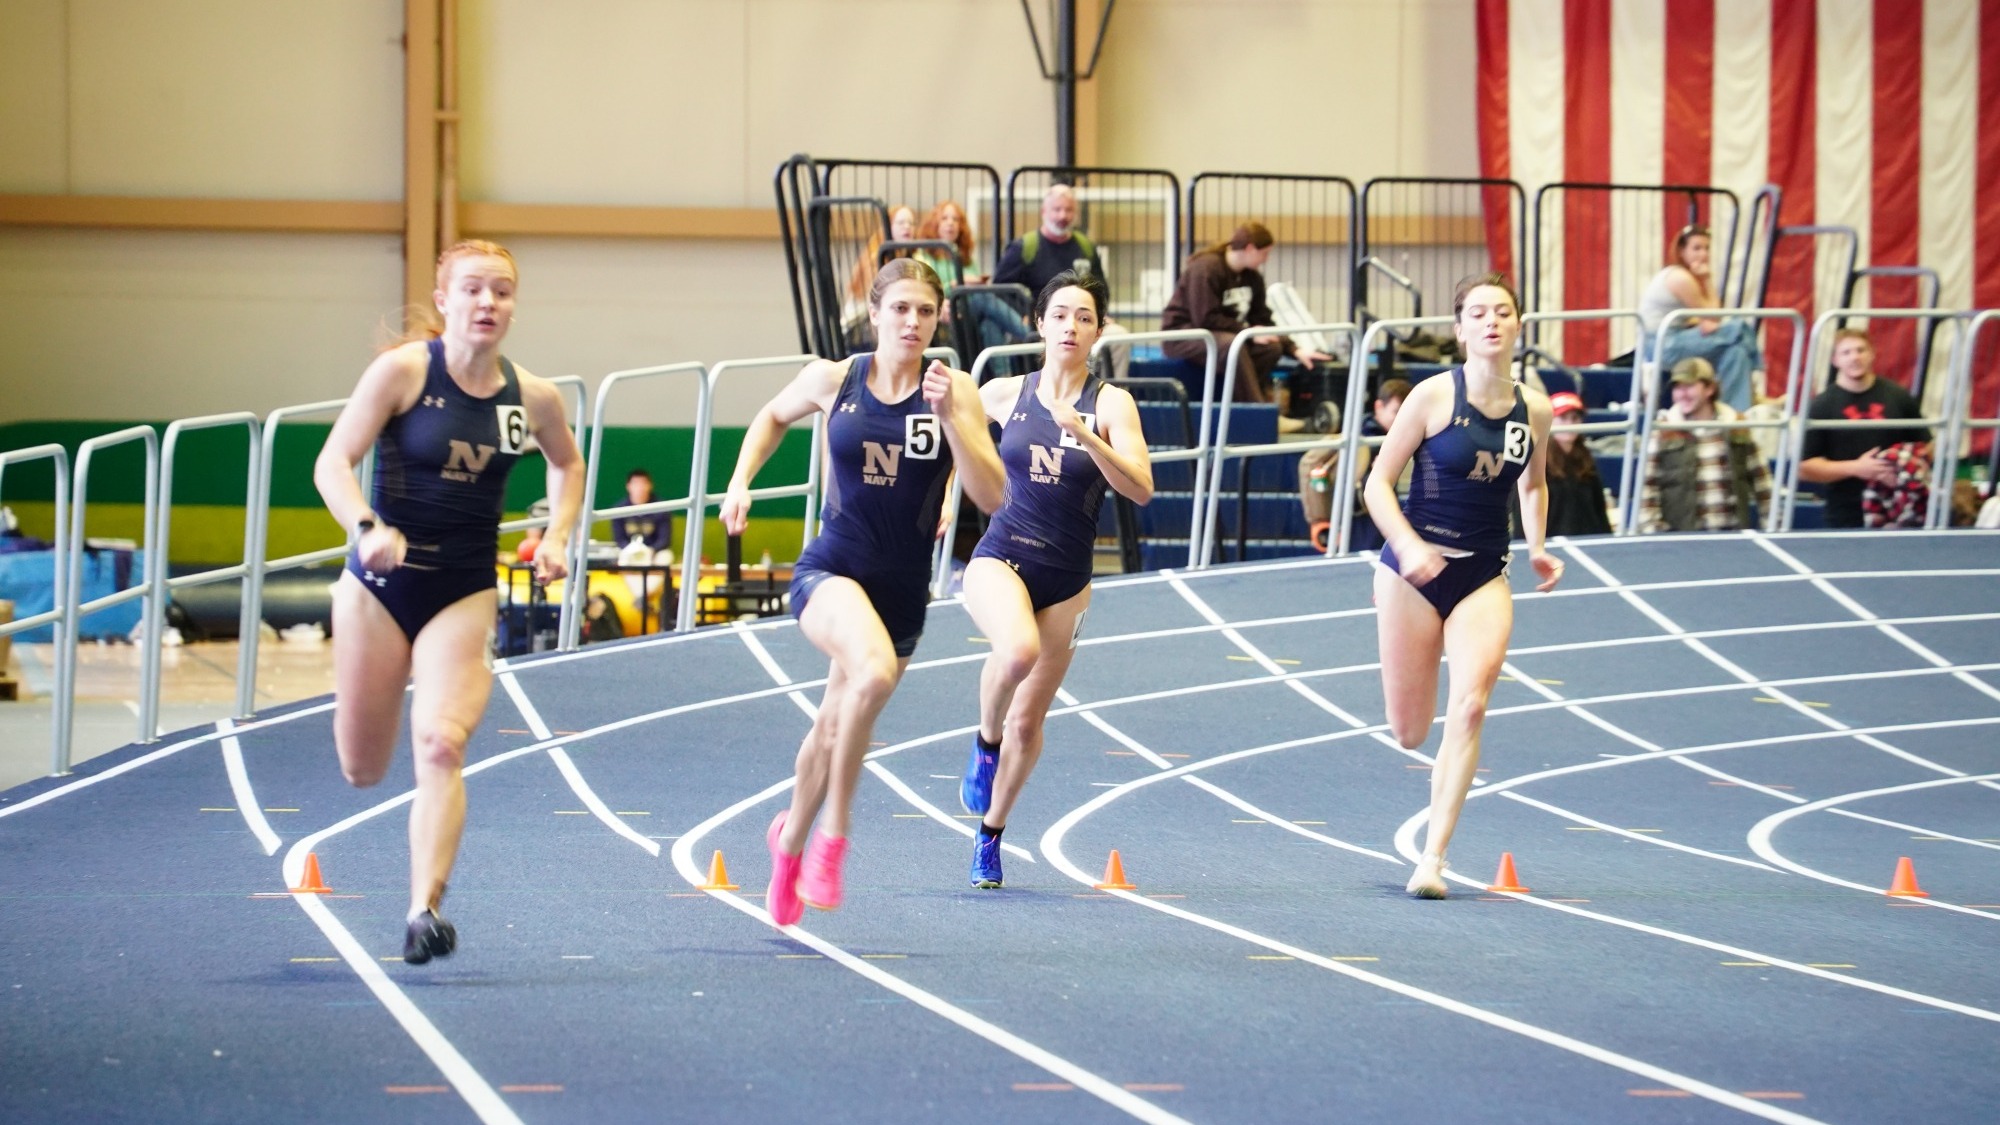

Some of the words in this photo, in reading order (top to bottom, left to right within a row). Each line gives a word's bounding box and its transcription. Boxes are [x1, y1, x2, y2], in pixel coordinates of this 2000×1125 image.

[507, 410, 523, 450] 6
[910, 418, 934, 455] 5
[1509, 427, 1526, 459] 3
[444, 440, 497, 473] N
[862, 441, 903, 476] N
[1029, 444, 1066, 477] N
[863, 474, 897, 487] NAVY
[1030, 473, 1060, 485] NAVY
